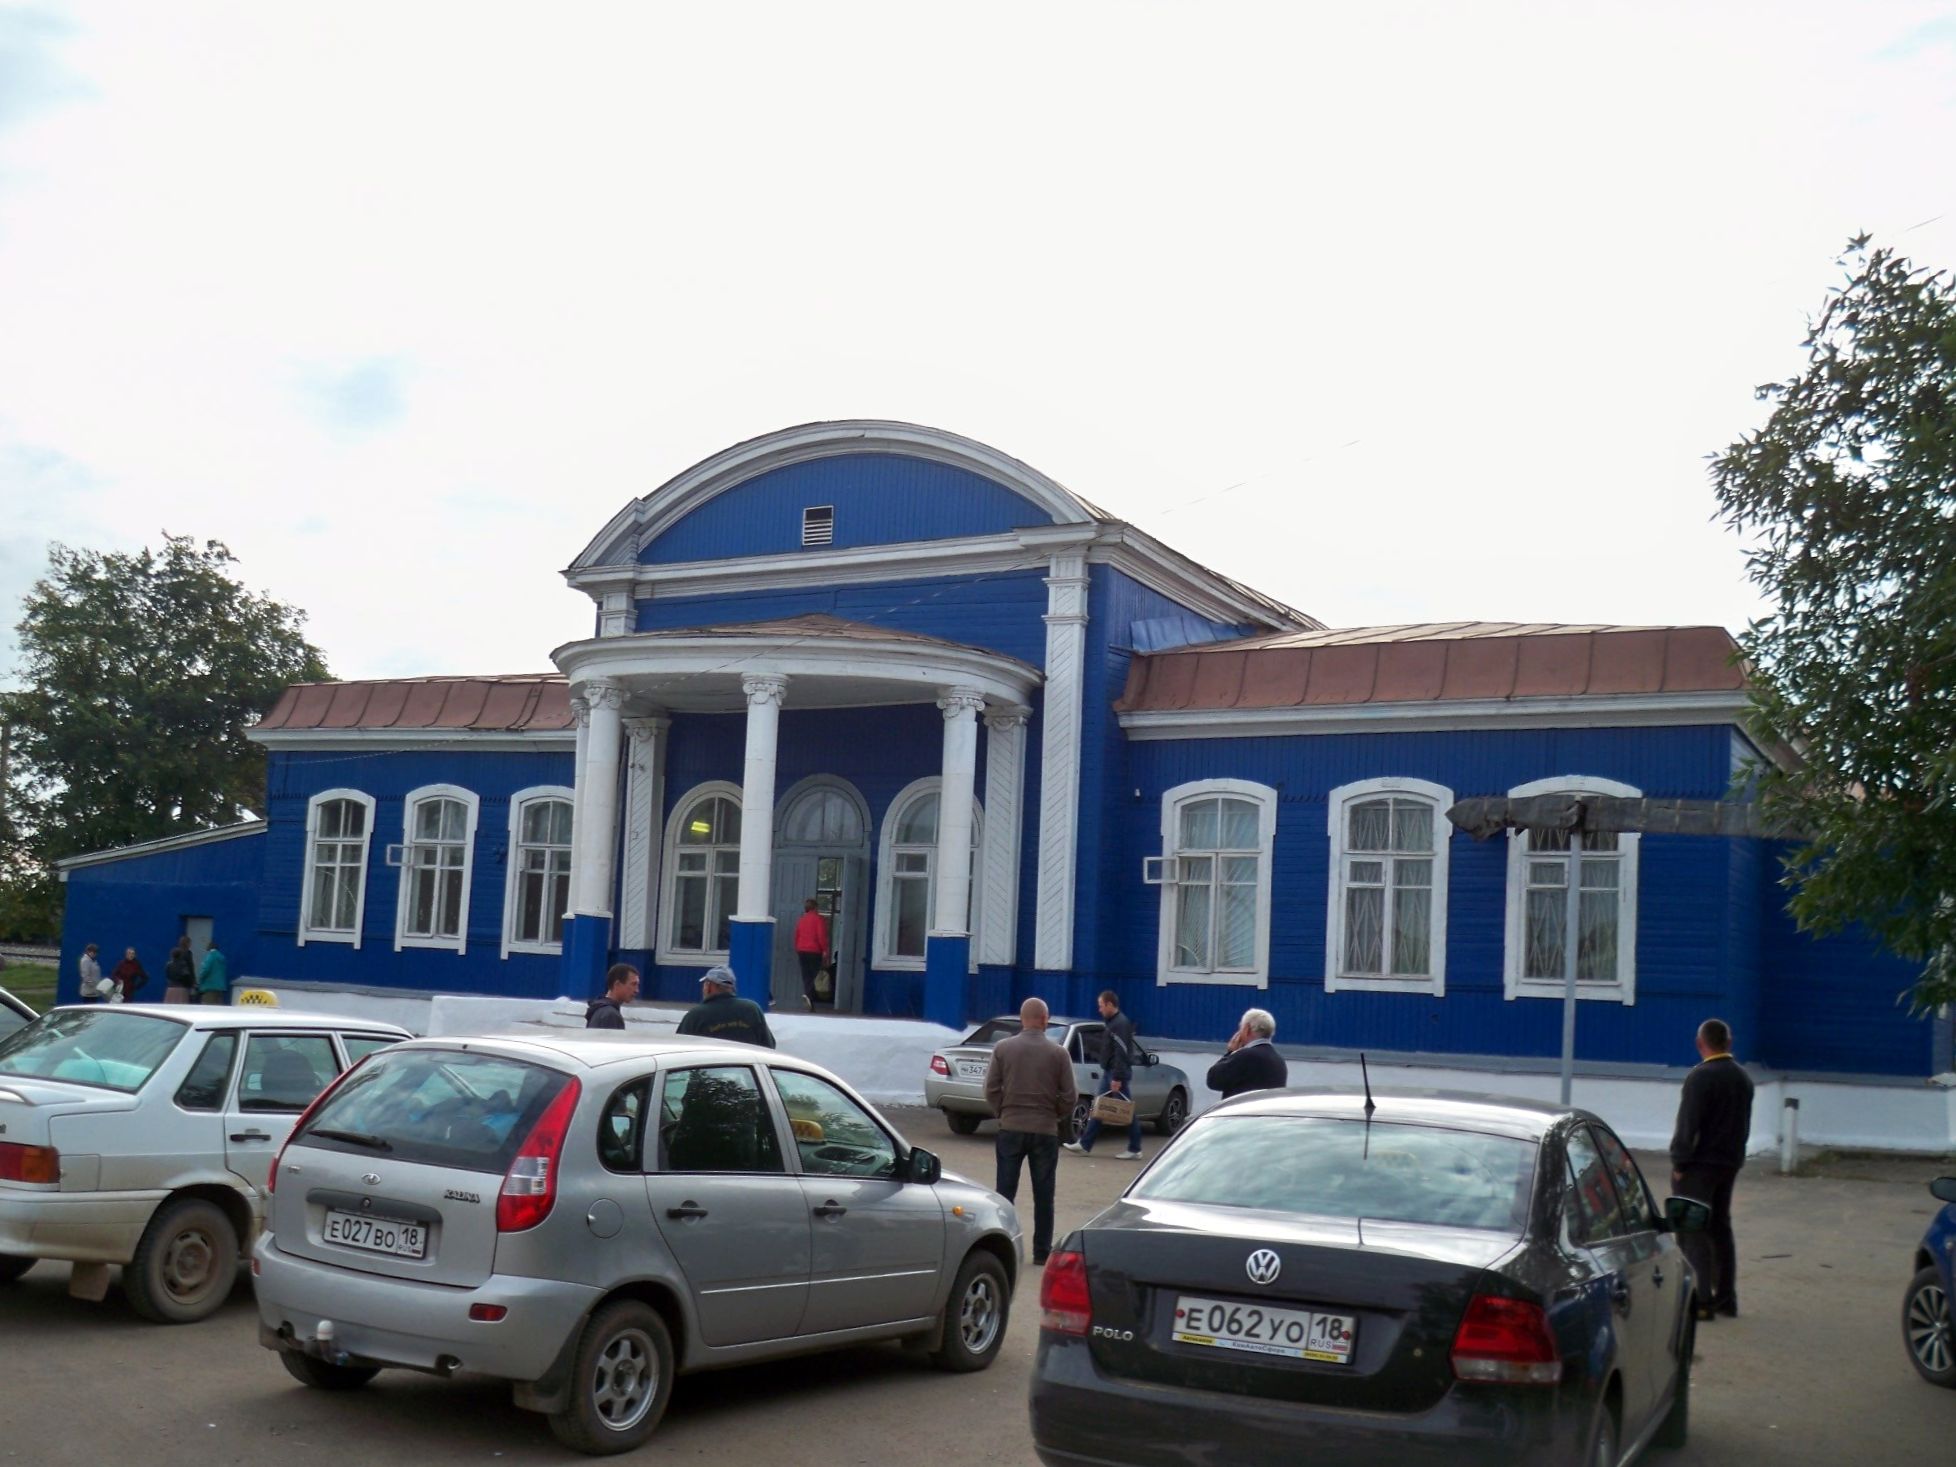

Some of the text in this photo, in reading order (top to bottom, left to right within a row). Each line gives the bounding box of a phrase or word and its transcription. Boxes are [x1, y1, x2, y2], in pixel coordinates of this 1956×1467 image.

[402, 1227, 418, 1246] 18
[1092, 1325, 1134, 1341] POLO
[1315, 1316, 1343, 1340] 18
[1310, 1338, 1332, 1350] RUS
